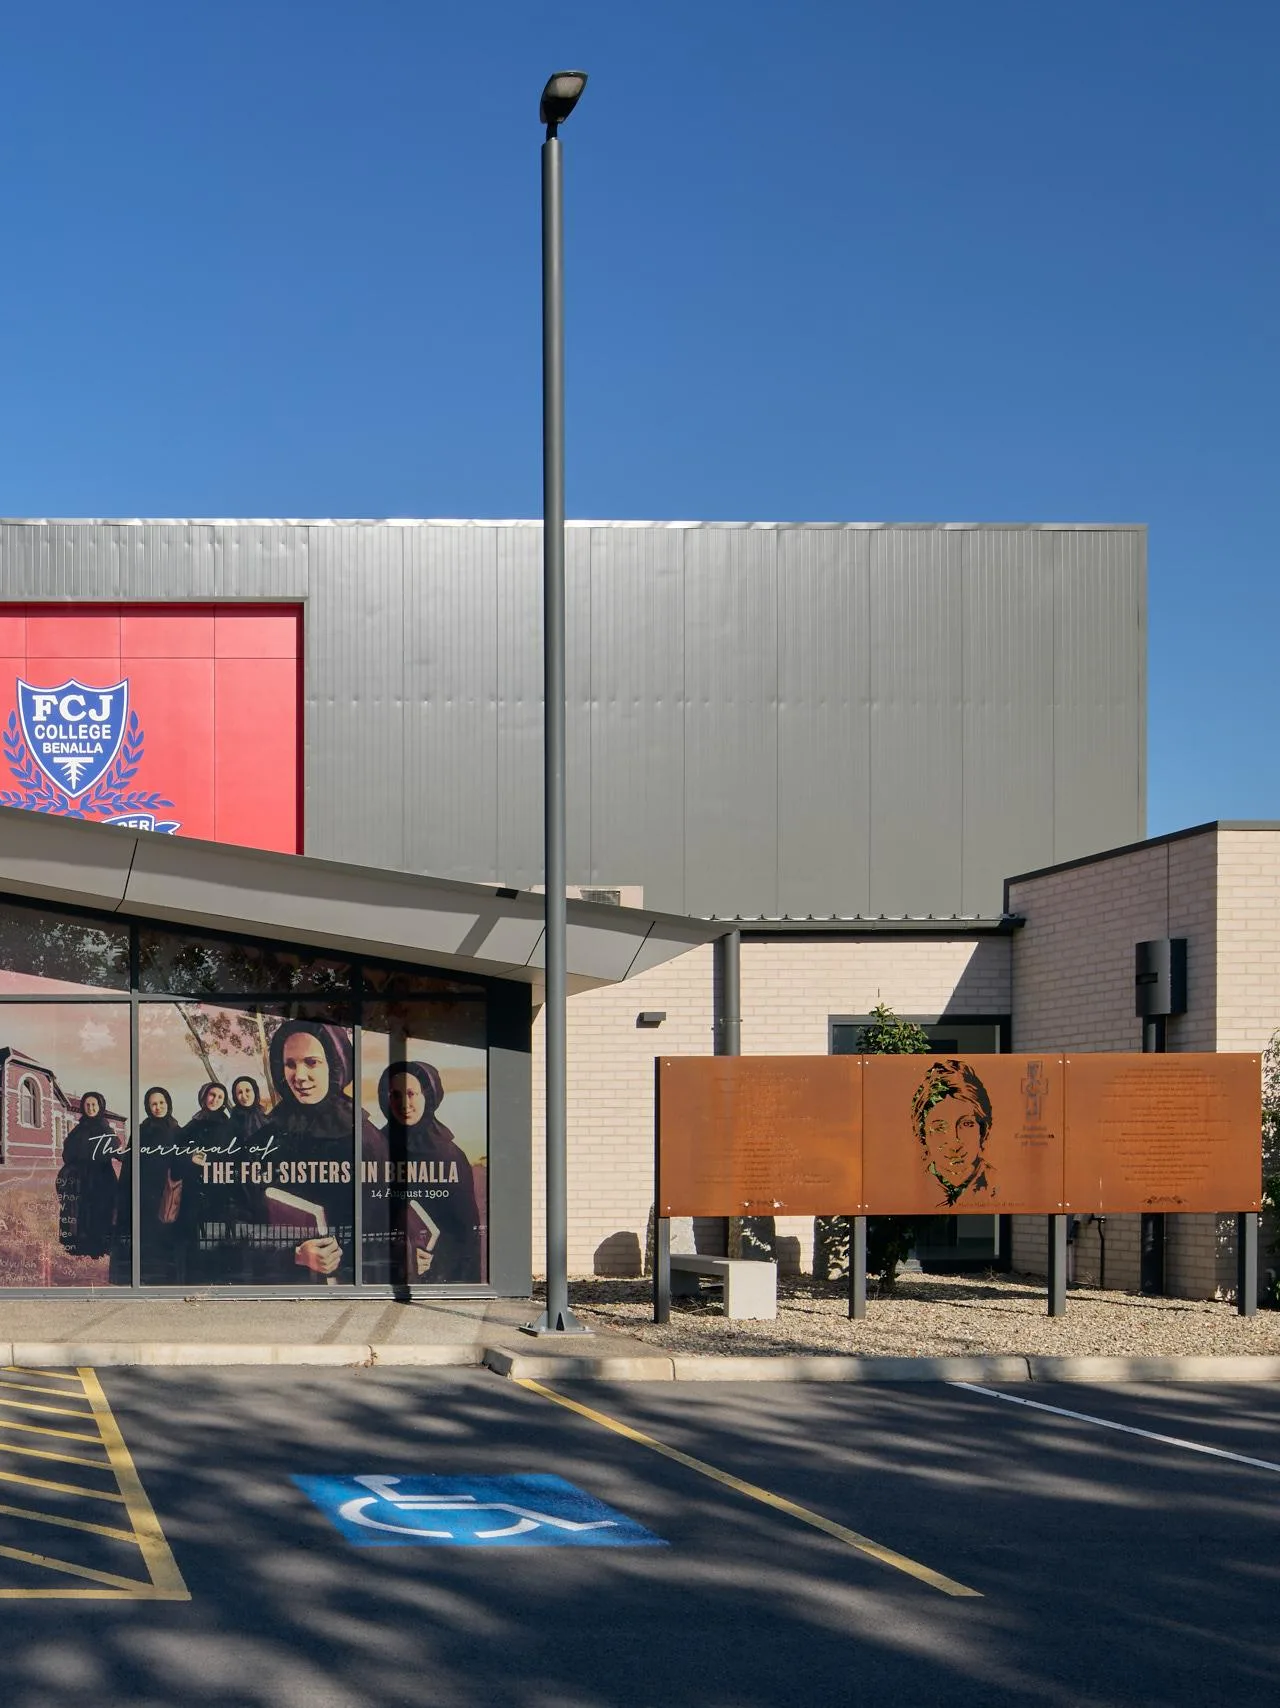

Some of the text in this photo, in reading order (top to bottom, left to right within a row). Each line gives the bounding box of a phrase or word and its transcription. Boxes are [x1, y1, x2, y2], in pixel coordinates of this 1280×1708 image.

[32, 694, 114, 722] FCJ
[34, 724, 112, 740] COLLEGE
[42, 742, 104, 754] BENALLA
[88, 1133, 277, 1161] The arrival of
[202, 1160, 459, 1184] THE FCJ SISTERS IN BENALLA
[371, 1188, 450, 1200] 14 August 1900
